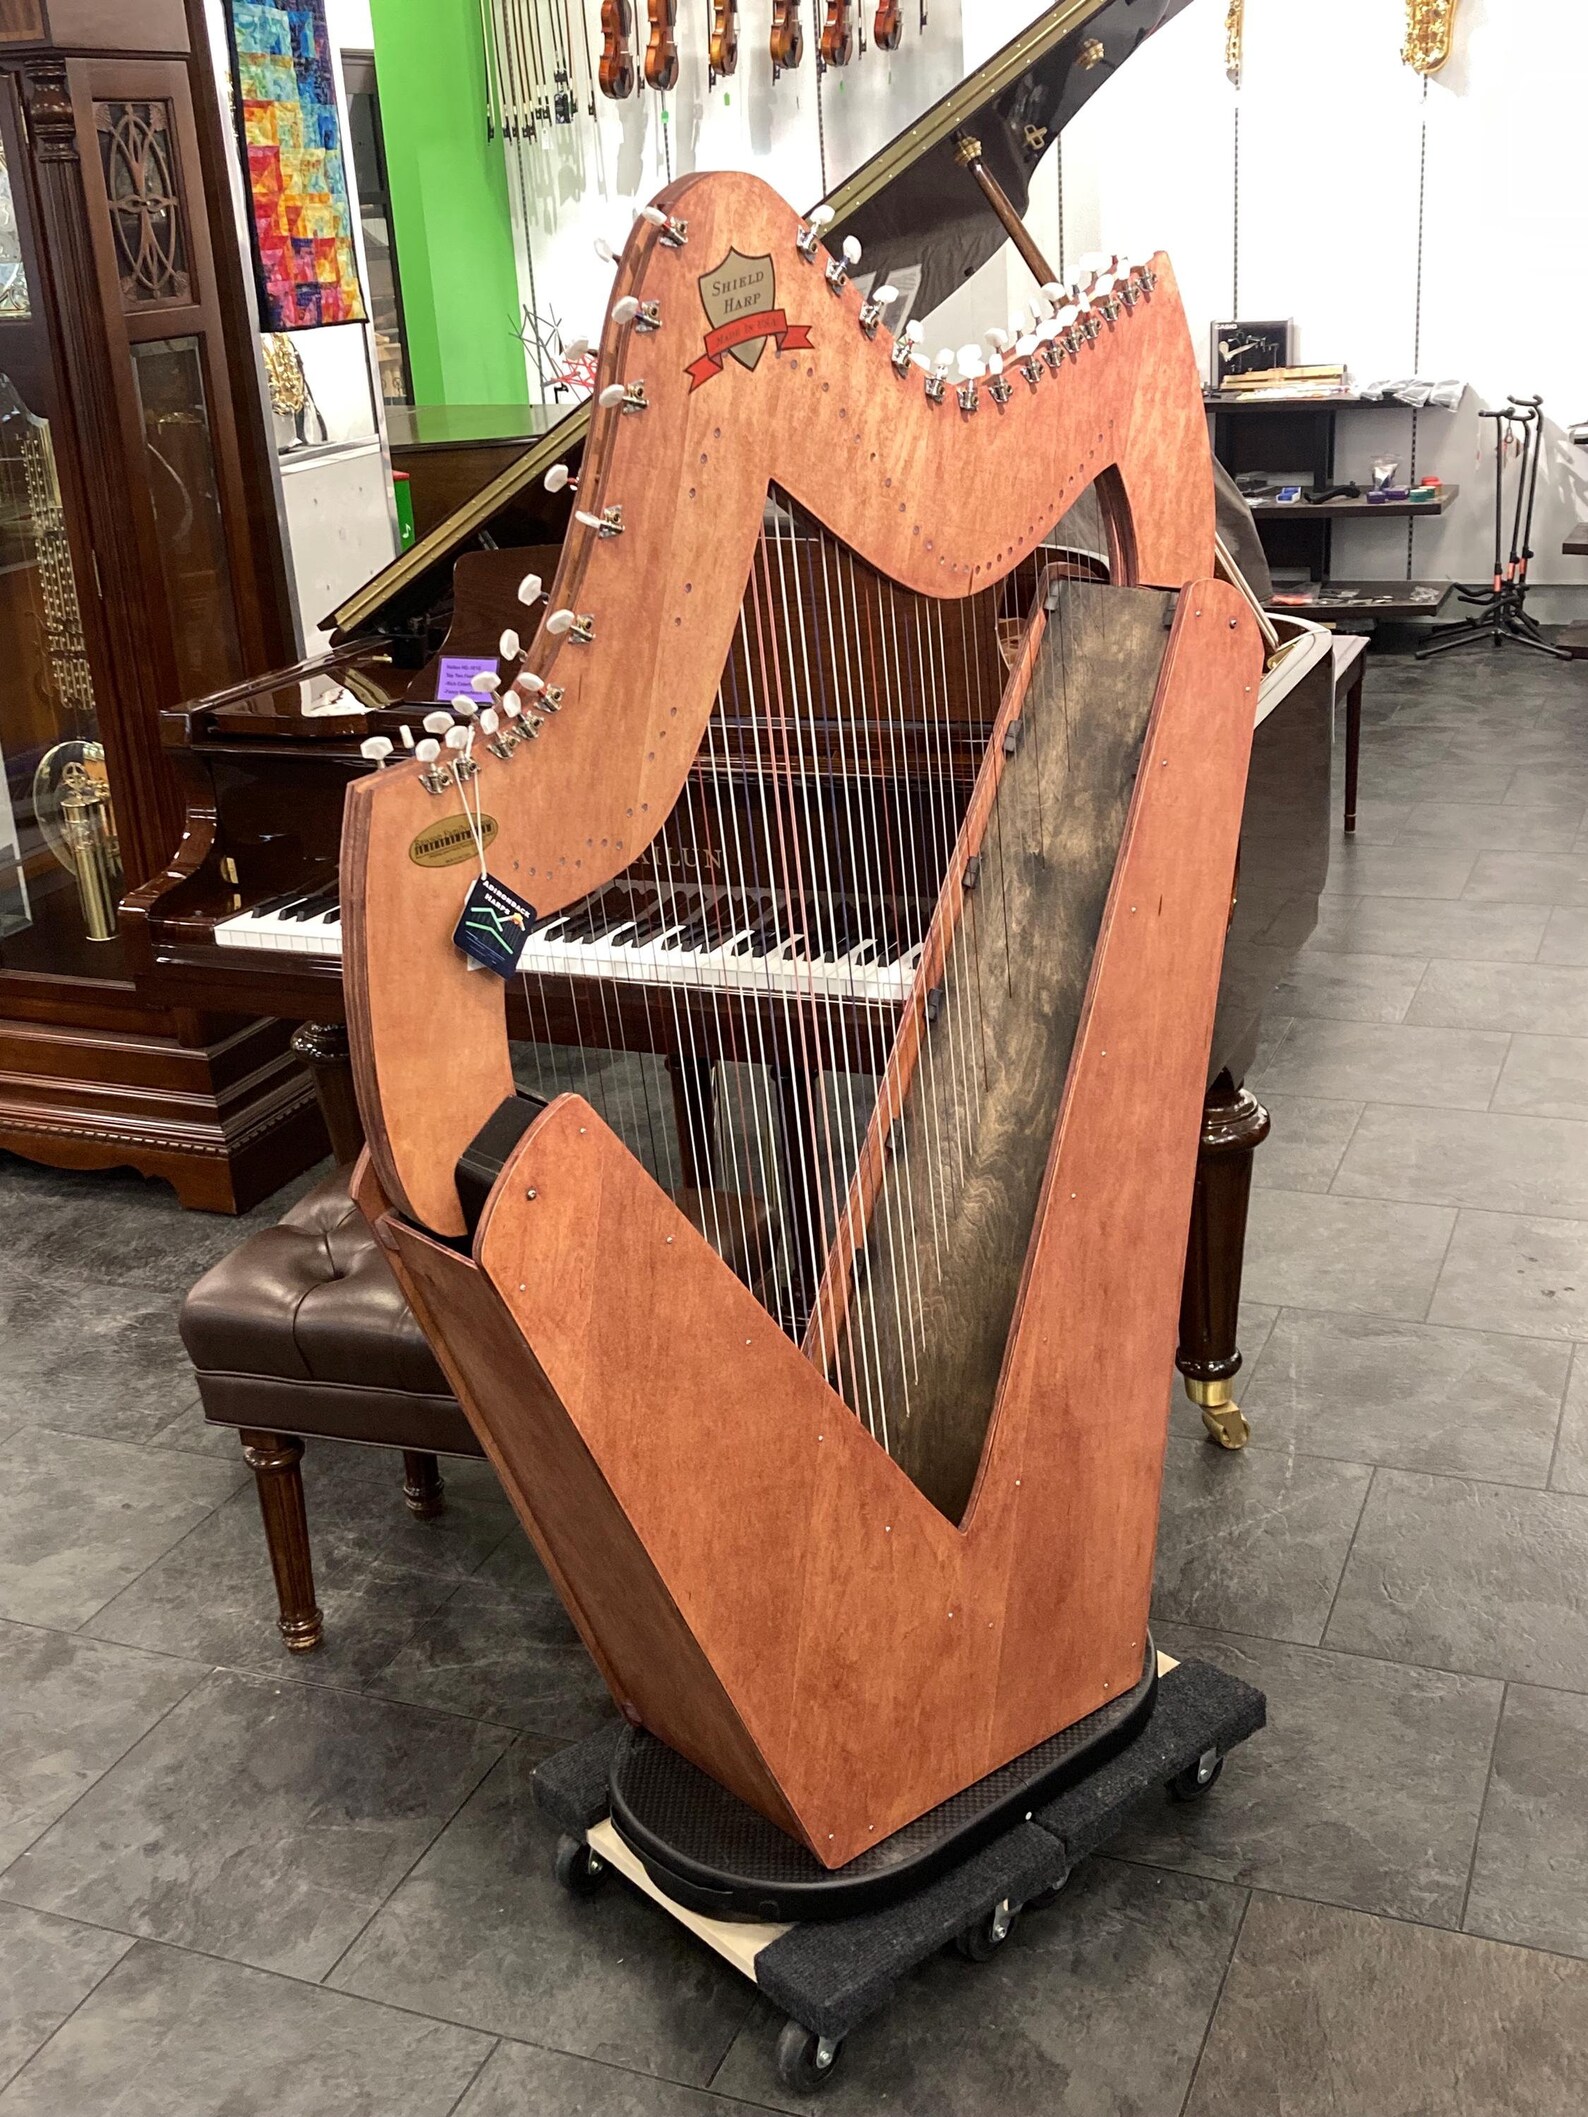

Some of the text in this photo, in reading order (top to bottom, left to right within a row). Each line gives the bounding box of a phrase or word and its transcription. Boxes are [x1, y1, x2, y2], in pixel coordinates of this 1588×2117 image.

[712, 271, 764, 297] SHIELD
[723, 293, 761, 314] HARP
[632, 846, 722, 868] AILUN
[483, 880, 530, 918] ADIRONDACK
[484, 892, 511, 915] HARPS
